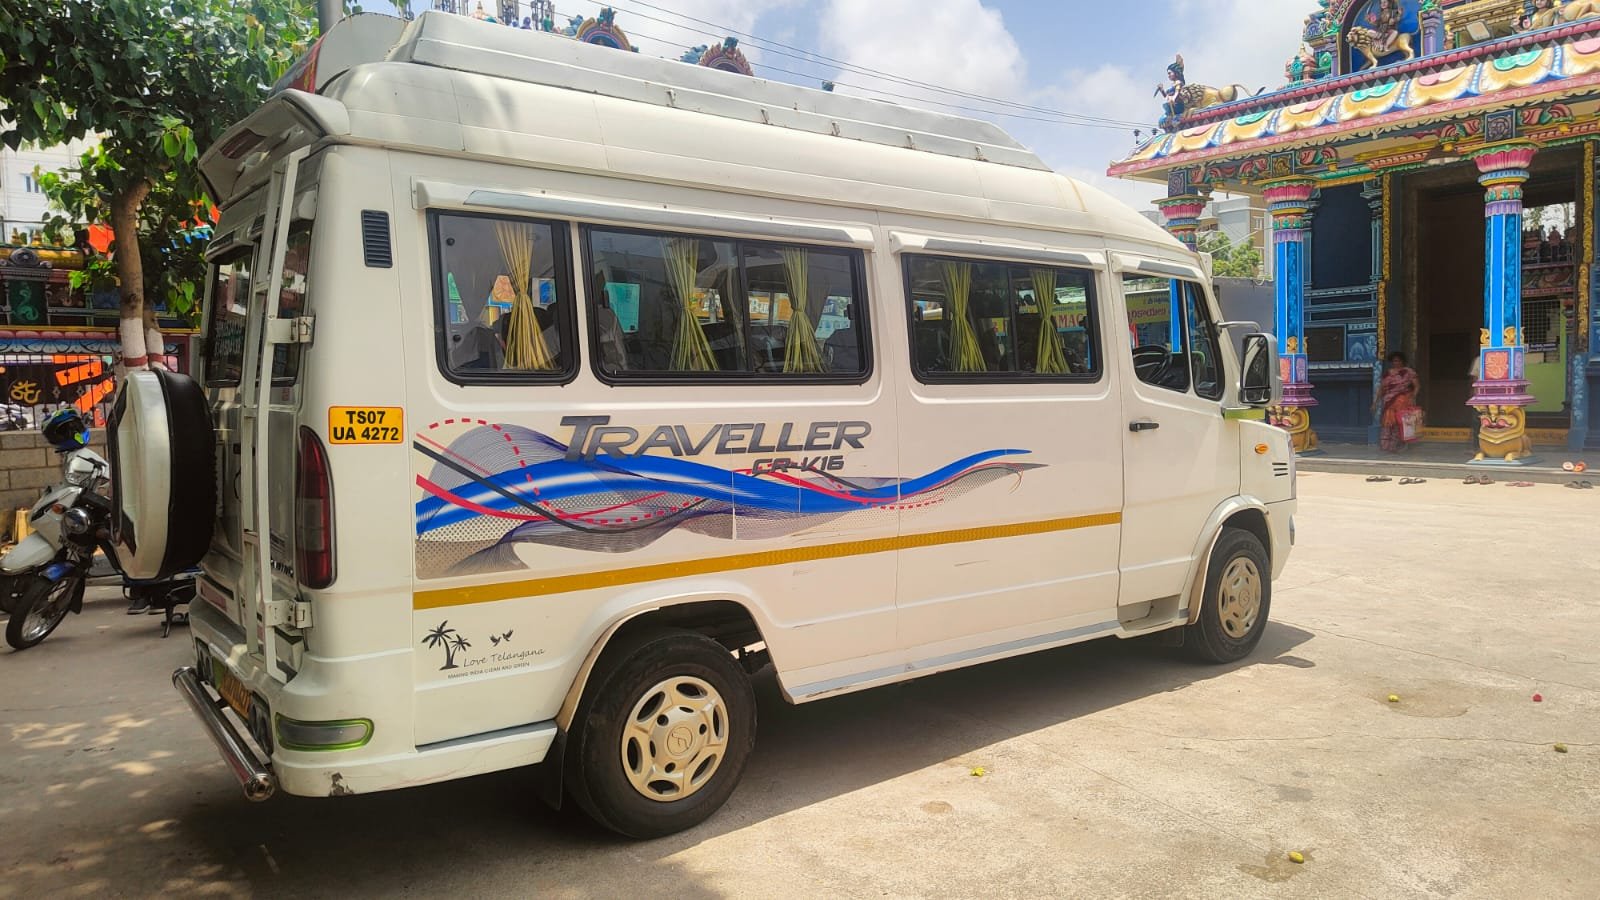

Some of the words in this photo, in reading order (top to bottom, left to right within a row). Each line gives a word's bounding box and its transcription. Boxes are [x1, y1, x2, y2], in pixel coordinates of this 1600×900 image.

[345, 410, 386, 425] TS07
[333, 426, 356, 440] UA
[361, 426, 399, 440] 4272
[559, 415, 872, 461] TRAVELLER
[463, 656, 488, 668] Love
[491, 648, 545, 664] Telangana
